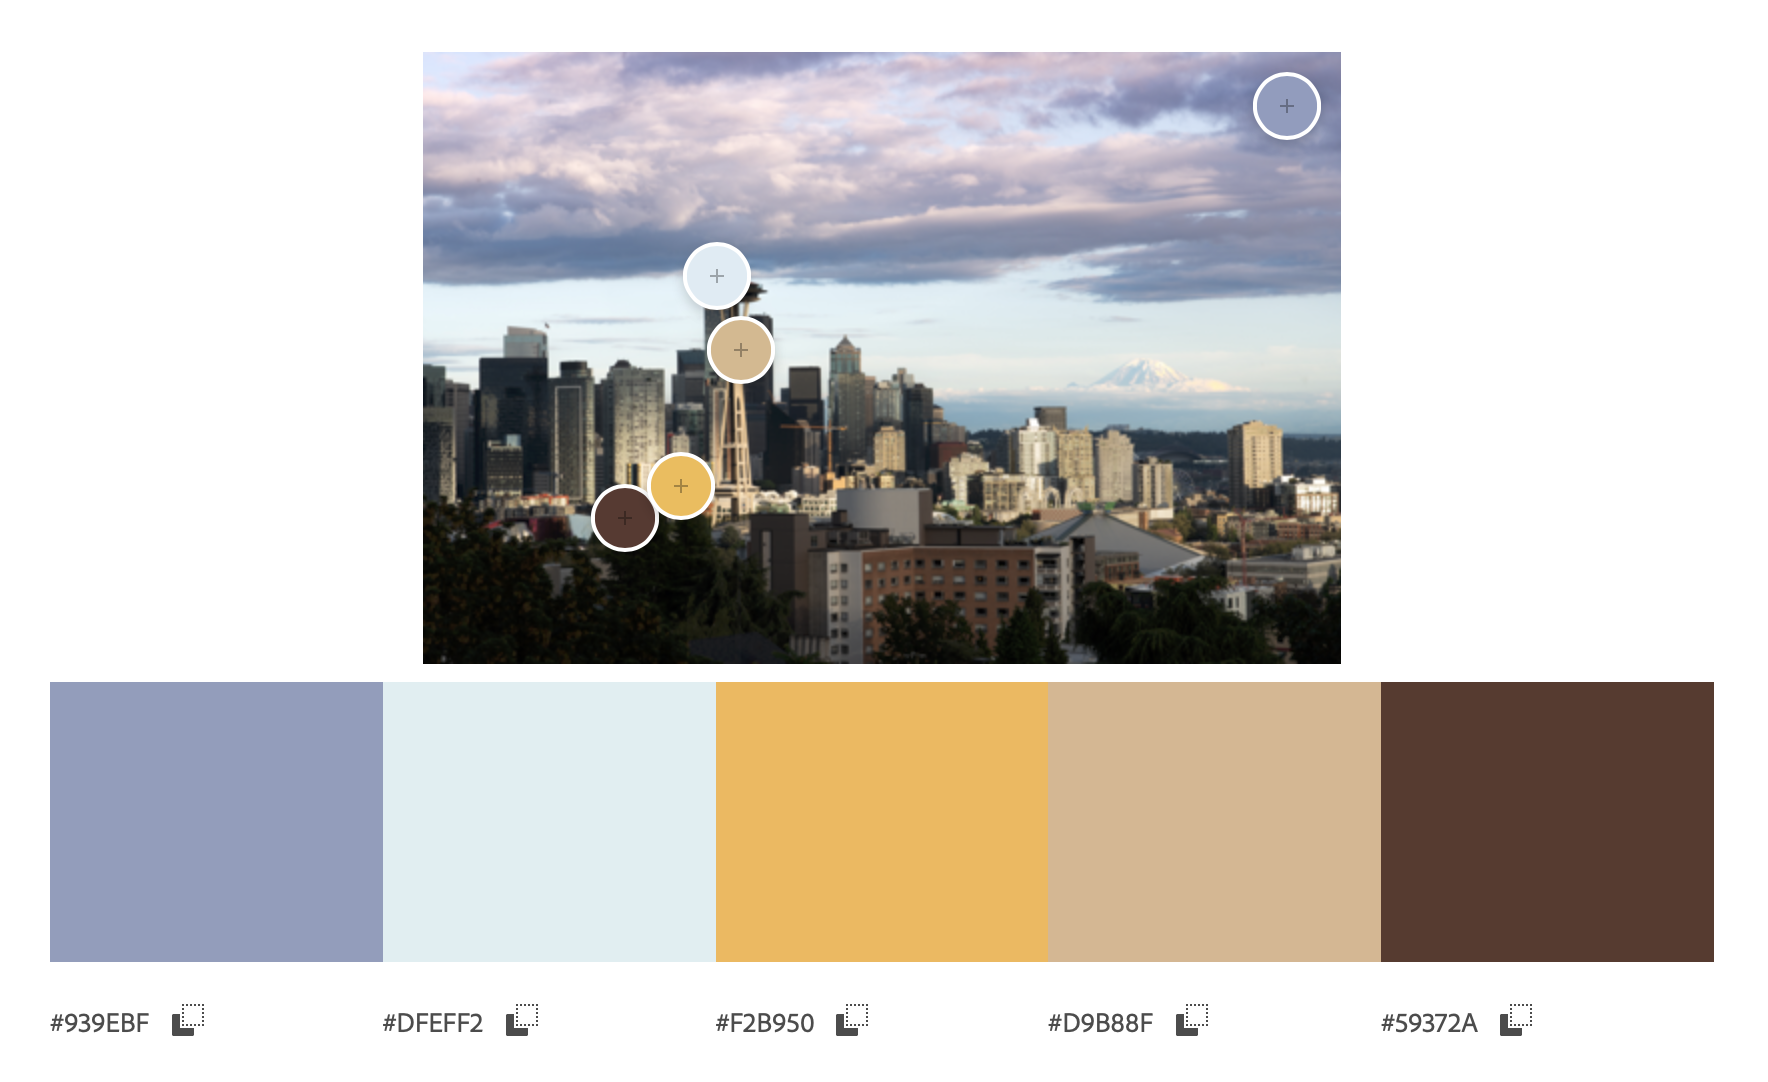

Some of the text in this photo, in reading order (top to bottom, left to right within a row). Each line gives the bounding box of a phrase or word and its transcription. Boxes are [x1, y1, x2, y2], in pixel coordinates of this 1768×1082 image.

[50, 1012, 149, 1033] #939EBF
[382, 1012, 483, 1033] #DFEFF2
[715, 1012, 815, 1033] #F2B950
[1048, 1012, 1154, 1033] #D9B88F
[1381, 1012, 1479, 1033] #59372A
